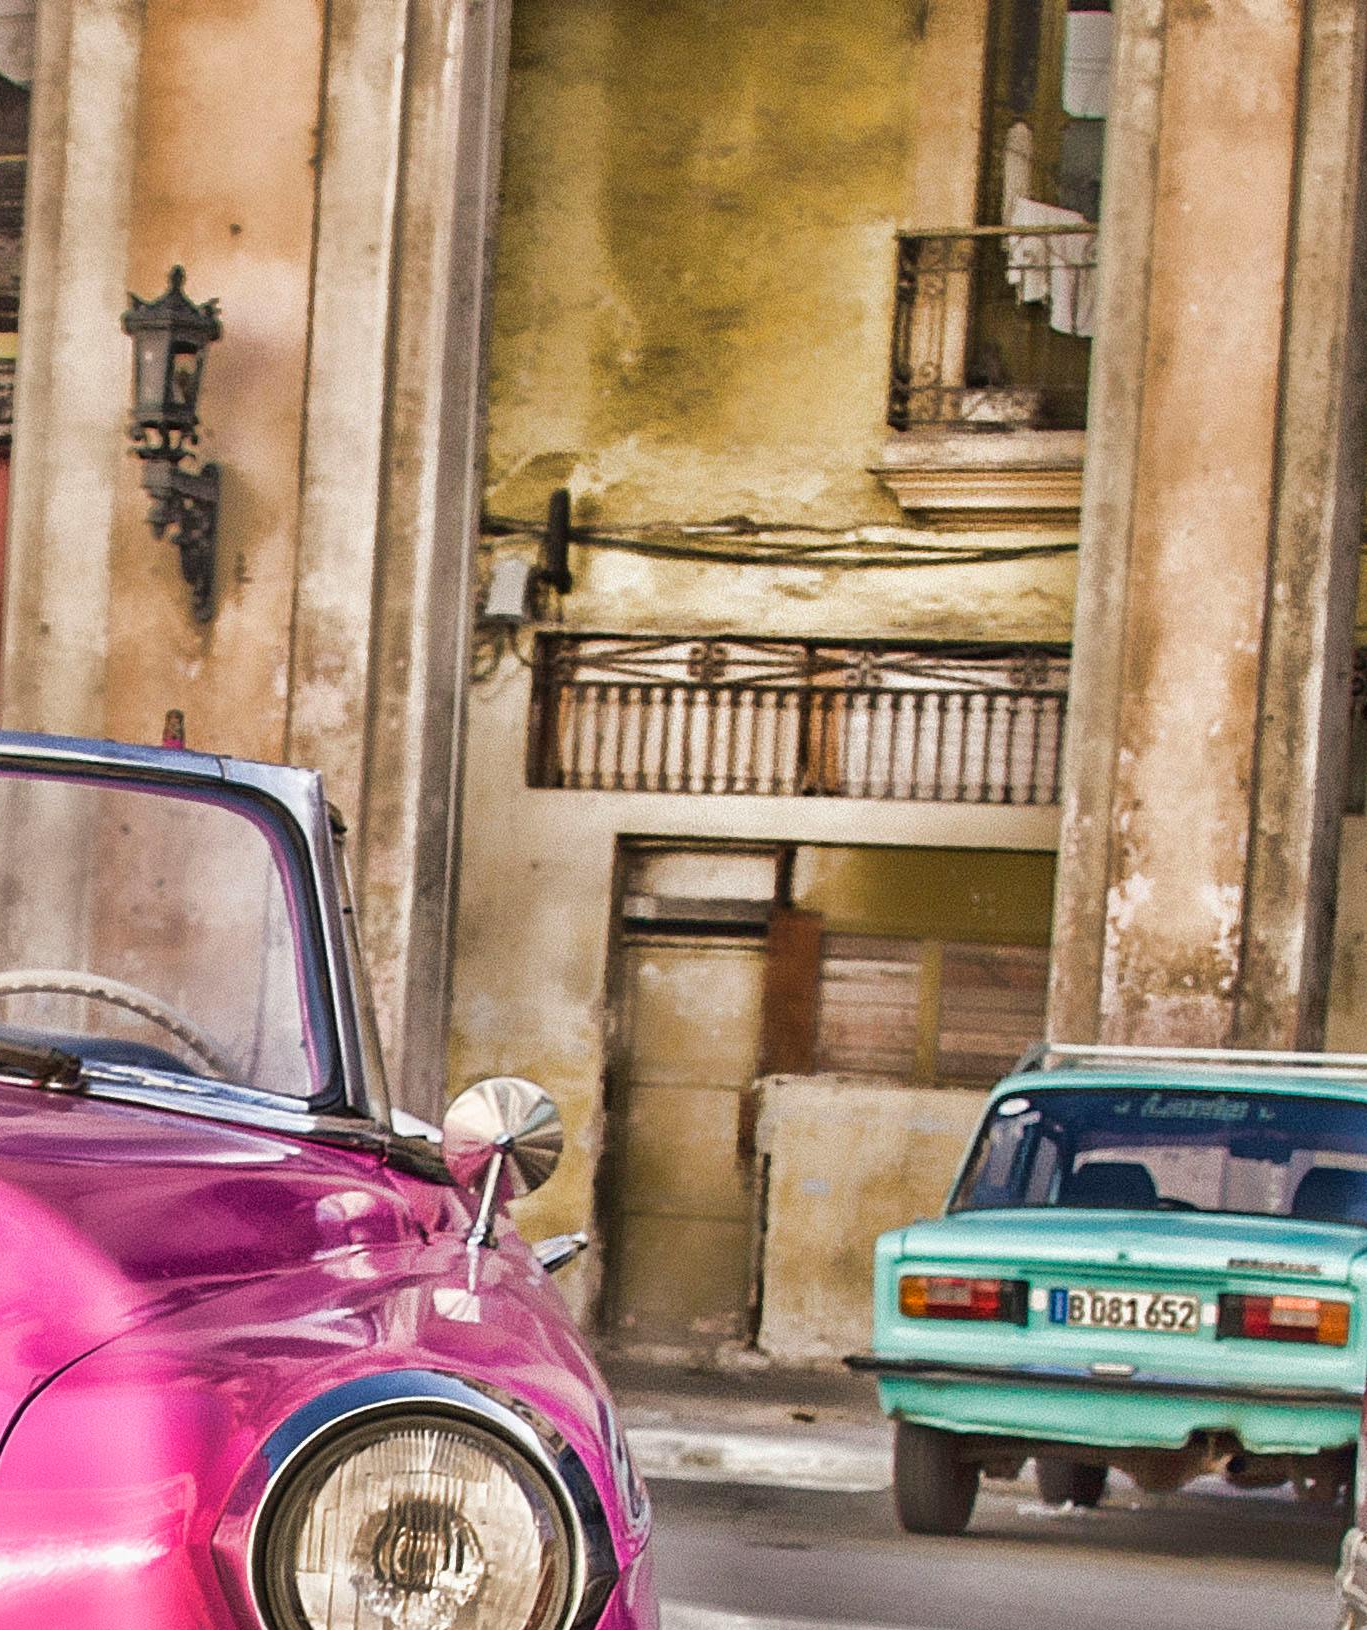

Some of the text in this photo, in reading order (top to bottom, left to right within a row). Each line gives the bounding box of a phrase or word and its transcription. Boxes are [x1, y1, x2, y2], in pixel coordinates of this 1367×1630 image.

[1069, 1295, 1086, 1322] B
[1091, 1296, 1138, 1326] 081
[1145, 1298, 1195, 1329] 652
